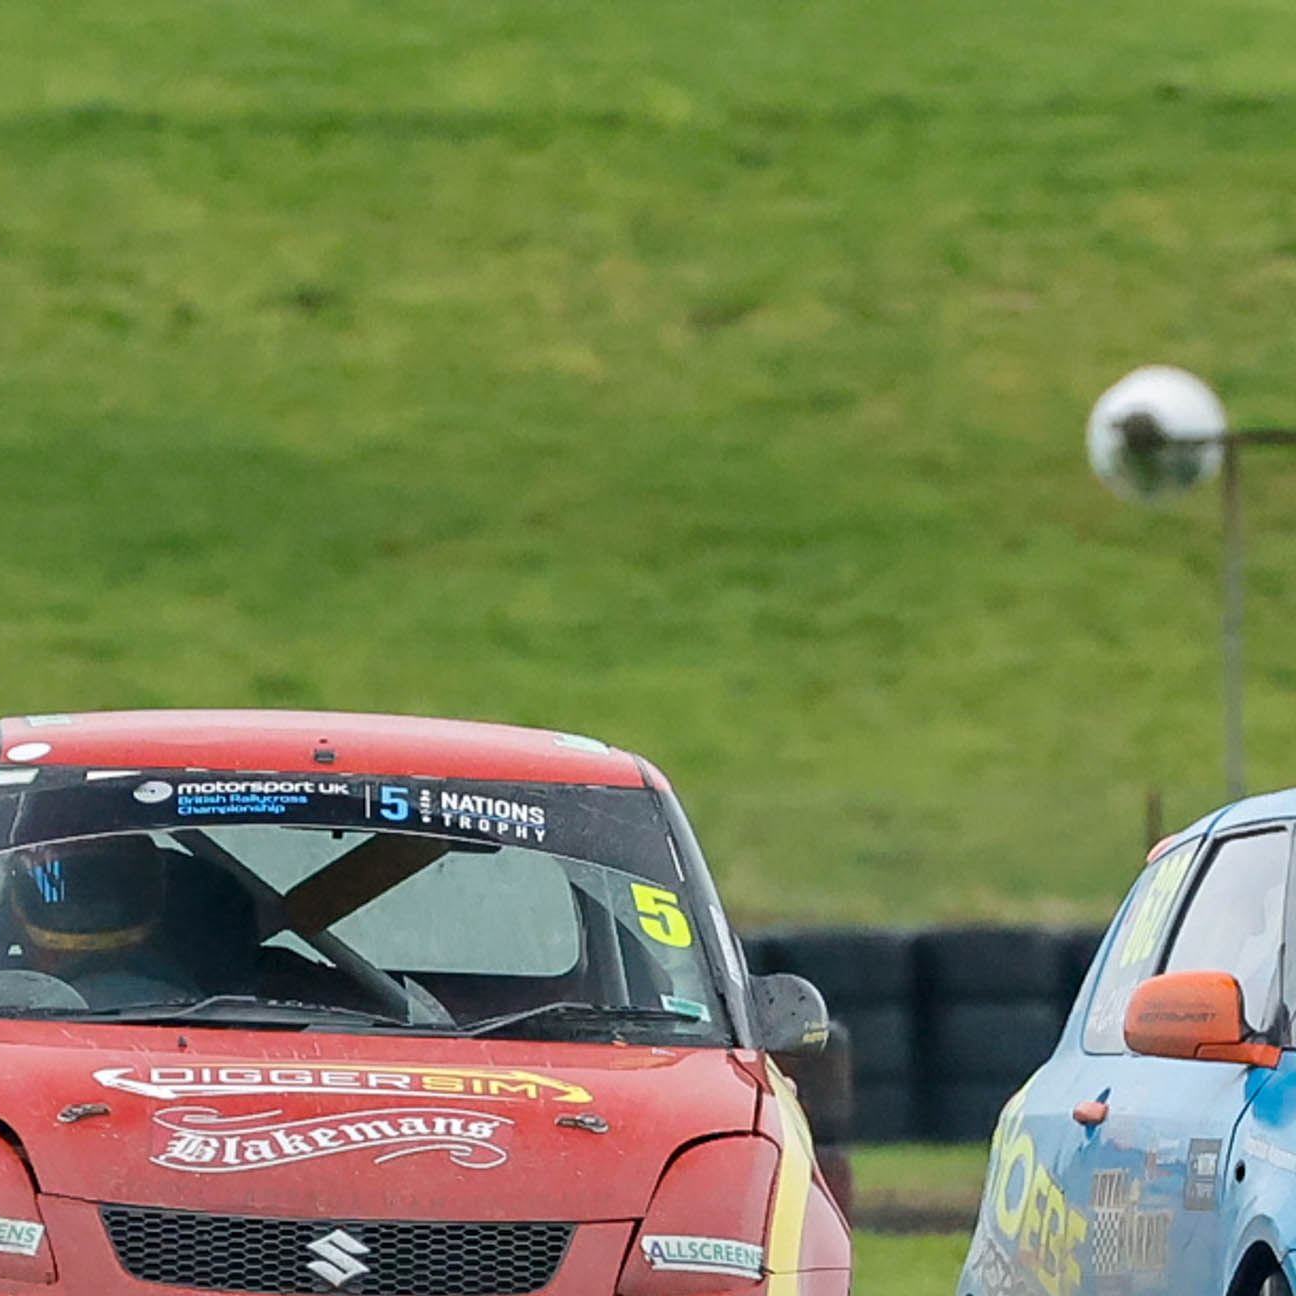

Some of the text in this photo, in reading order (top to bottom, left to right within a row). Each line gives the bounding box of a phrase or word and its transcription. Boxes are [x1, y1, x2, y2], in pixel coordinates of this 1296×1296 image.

[177, 780, 314, 796] motorsport
[177, 794, 308, 806] British Rallycross
[379, 784, 409, 822] 5
[177, 803, 286, 816] Championship
[440, 791, 546, 826] NATIONS
[441, 812, 546, 843] TROPHY
[629, 882, 693, 948] 5
[157, 1114, 501, 1165] Blakemans
